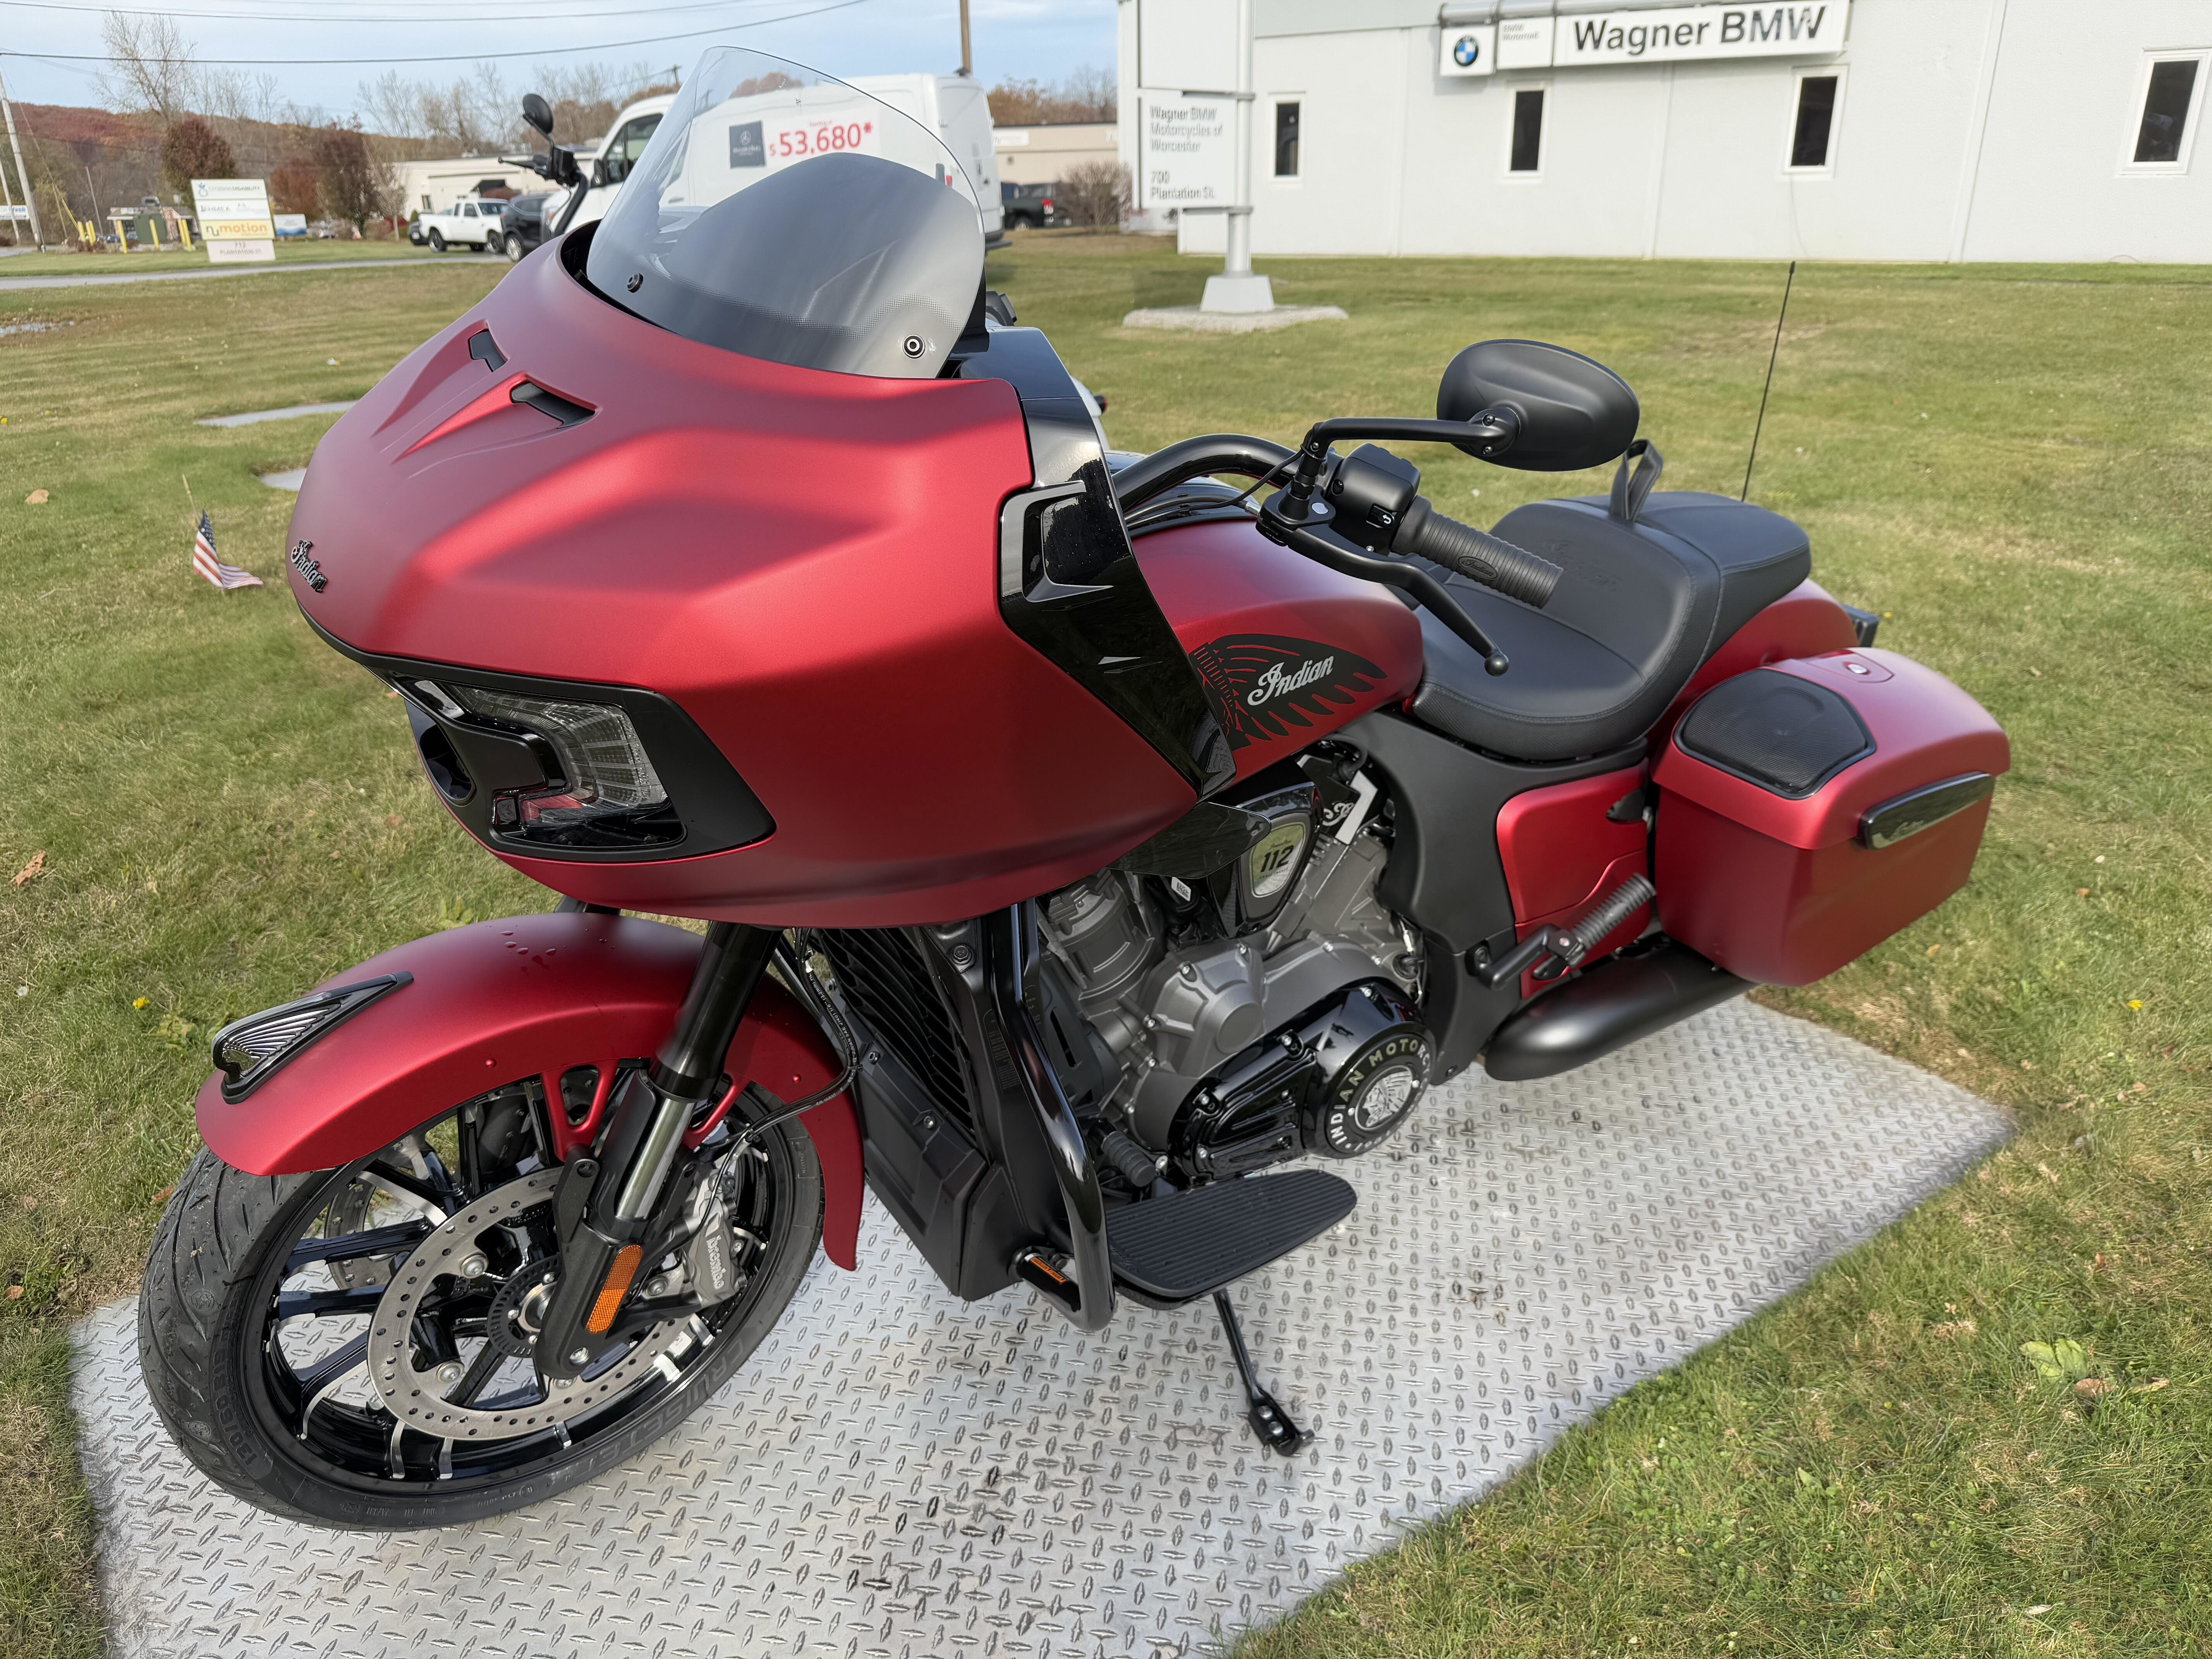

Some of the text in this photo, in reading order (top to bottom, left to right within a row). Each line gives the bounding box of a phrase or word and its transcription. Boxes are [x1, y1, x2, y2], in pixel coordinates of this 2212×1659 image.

[1574, 5, 1826, 56] Wagner BMW
[1150, 106, 1217, 123] Wagner BMW
[1151, 186, 1202, 199] Plantation
[291, 540, 328, 593] Indian
[1461, 558, 1494, 577] Indian
[1247, 656, 1334, 706] Indian
[1260, 844, 1294, 874] 112
[1330, 1070, 1365, 1146] INDIAN
[706, 1235, 725, 1289] brembo
